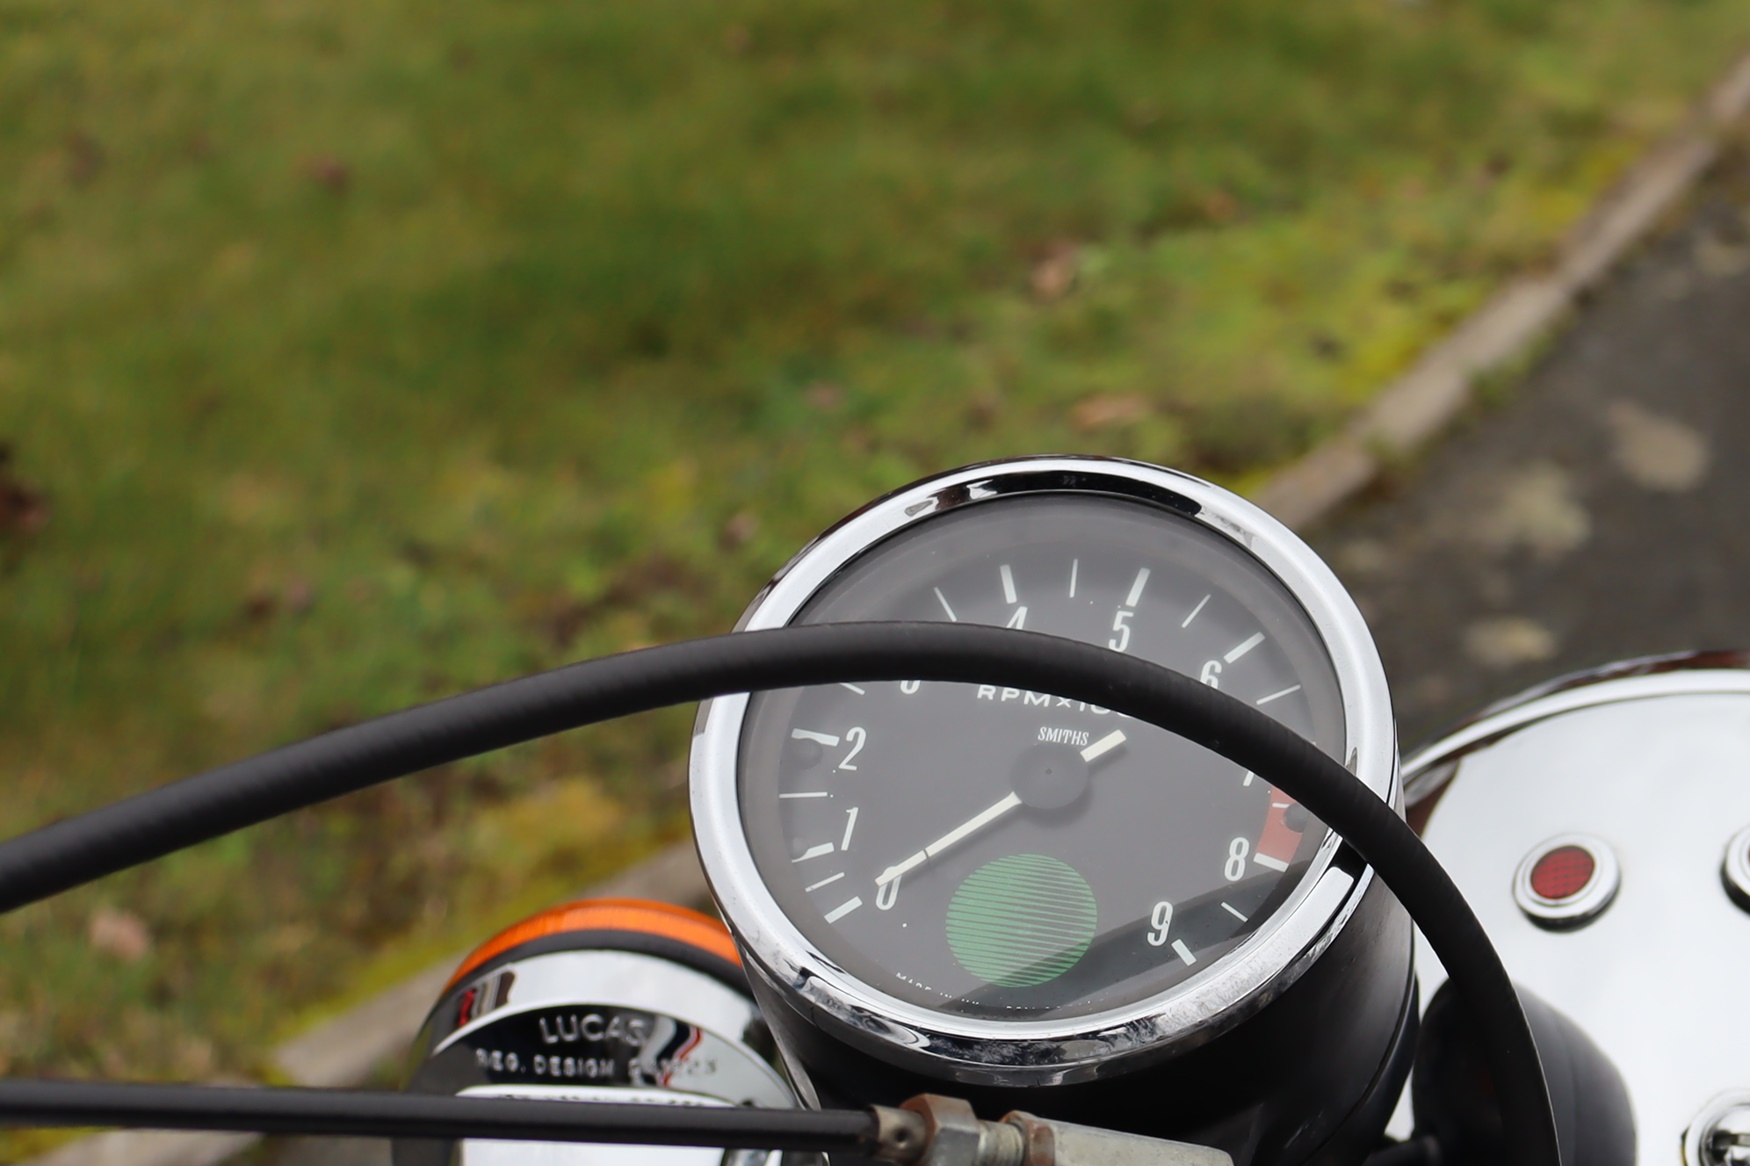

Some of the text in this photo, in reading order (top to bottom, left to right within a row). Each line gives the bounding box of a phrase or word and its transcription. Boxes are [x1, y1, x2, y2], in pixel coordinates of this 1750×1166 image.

[1109, 610, 1134, 653] 5
[837, 726, 867, 771] 2
[1037, 726, 1090, 747] SMITHS
[840, 806, 859, 851] 1
[1224, 836, 1250, 882] 8
[875, 866, 903, 911] 0
[1146, 901, 1174, 947] 9
[538, 1013, 645, 1046] LUCAS
[533, 1054, 615, 1079] DESIGN
